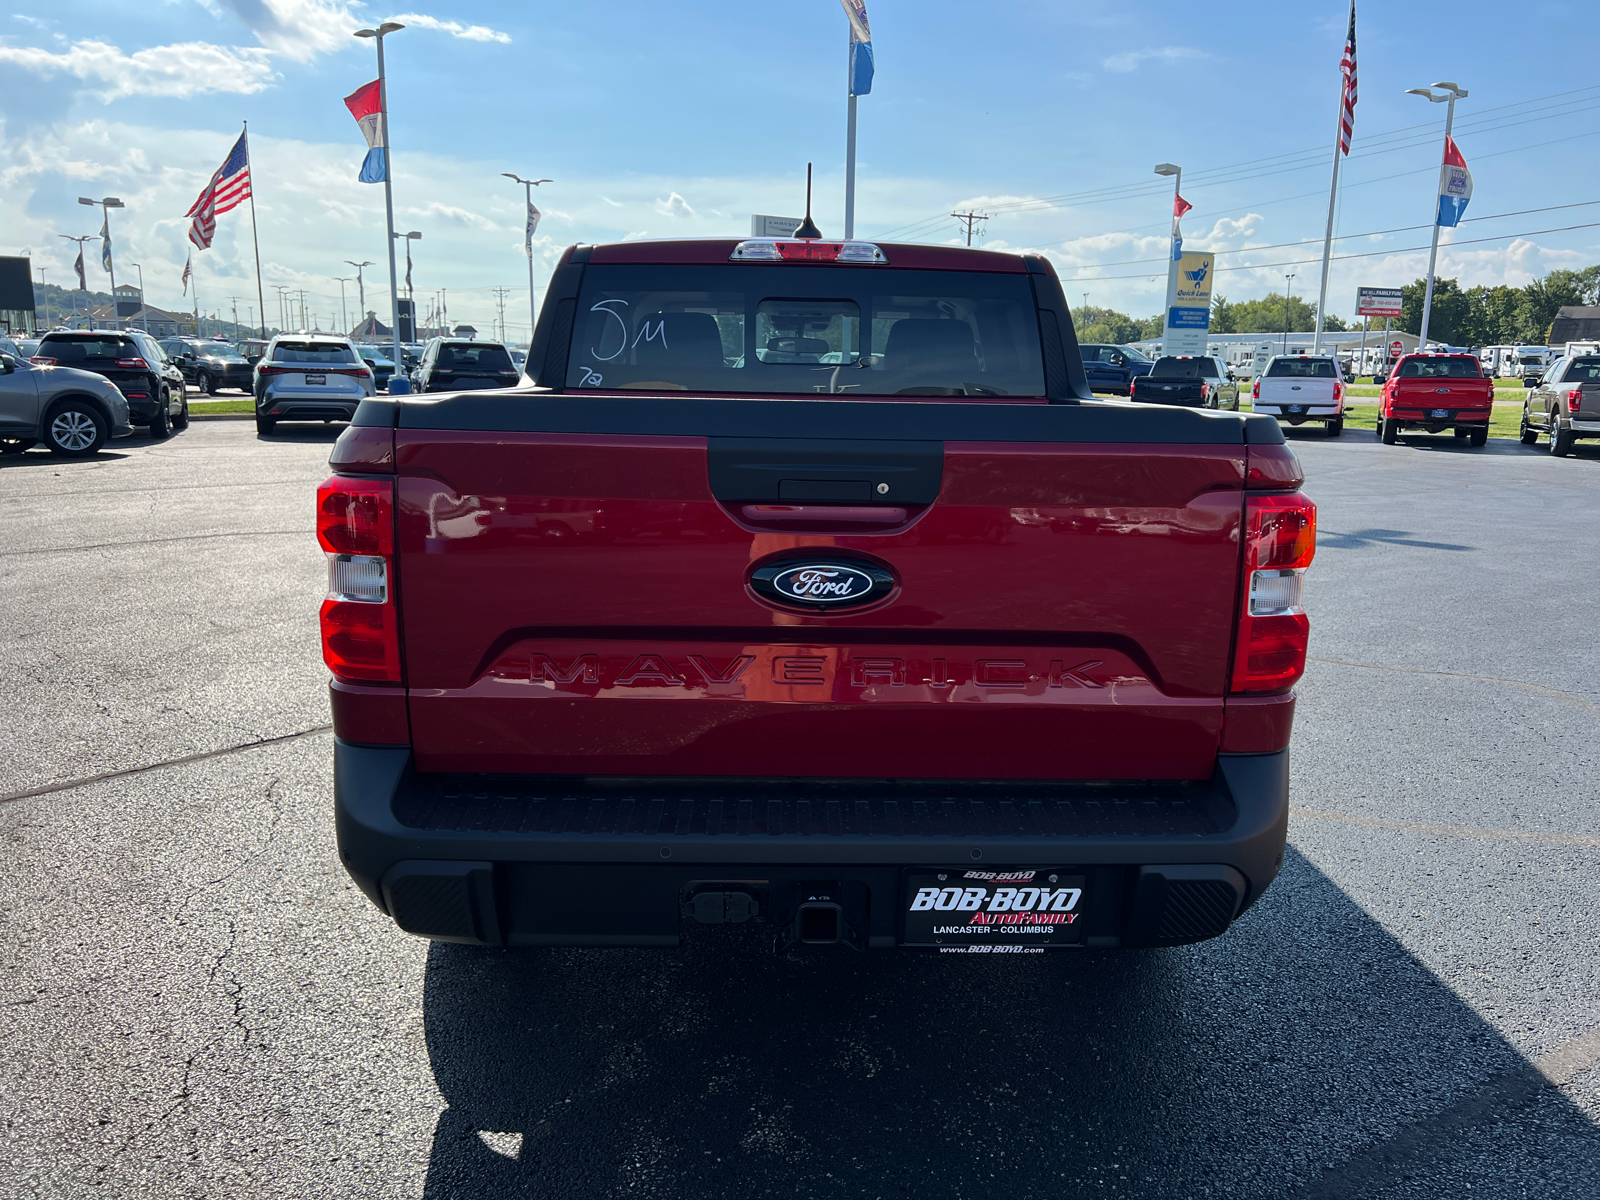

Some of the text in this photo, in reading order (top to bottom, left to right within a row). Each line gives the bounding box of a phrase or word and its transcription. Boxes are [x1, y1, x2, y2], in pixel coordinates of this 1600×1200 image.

[792, 570, 854, 595] Ford
[529, 653, 1104, 689] MAVERICK
[909, 887, 1082, 911] BOB-BOYD
[1000, 926, 1054, 934] COLUMBUS
